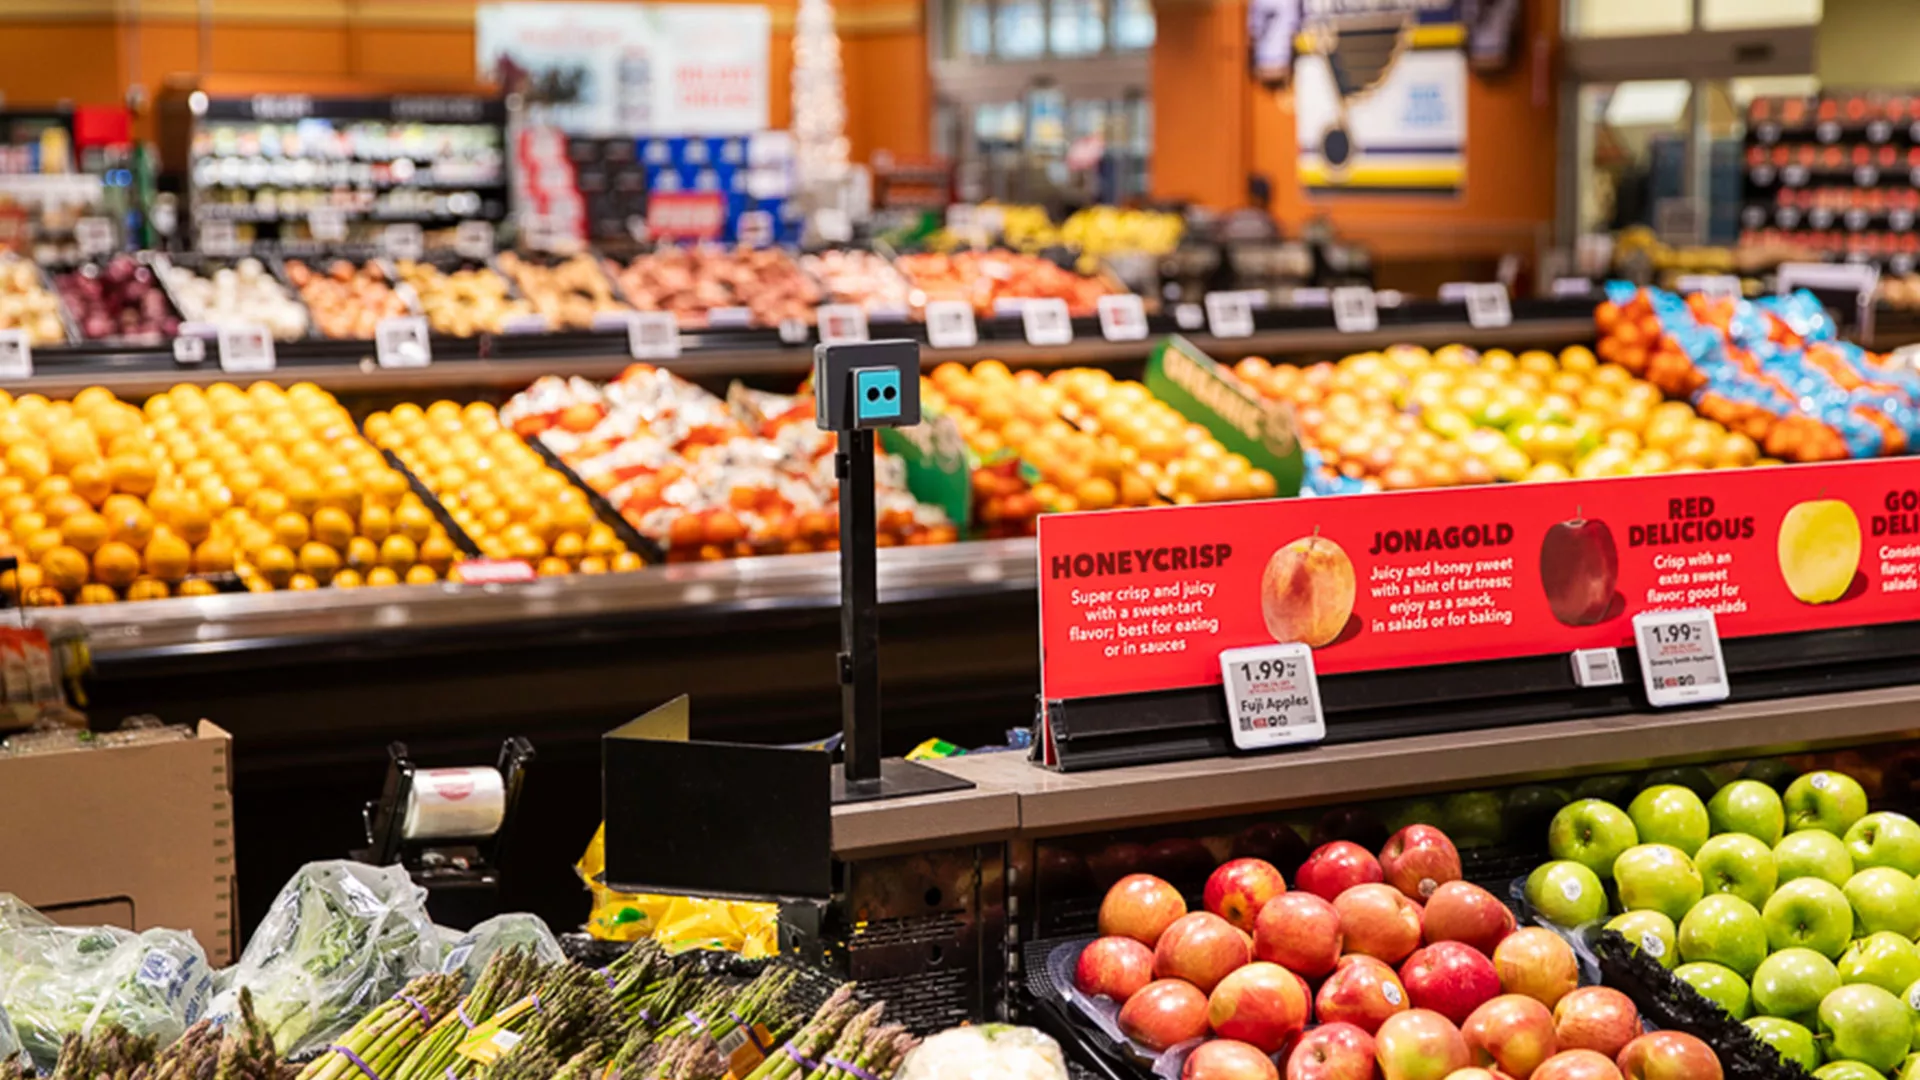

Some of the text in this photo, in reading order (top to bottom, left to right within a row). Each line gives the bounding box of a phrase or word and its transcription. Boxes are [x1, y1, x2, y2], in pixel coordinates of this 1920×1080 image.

[1668, 496, 1715, 520] RED
[1884, 489, 1920, 512] GO
[1628, 516, 1755, 547] DELICIOUS
[1871, 513, 1919, 537] DELI
[1369, 522, 1514, 555] JONAGOLD
[1052, 543, 1232, 579] HONEYCRISP
[1370, 557, 1513, 582] Juicy and honey sweet
[1653, 551, 1732, 570] Crisp with an
[1371, 576, 1512, 598] with a hint of tartness;
[1658, 568, 1728, 586] extra sweet
[1882, 576, 1918, 592] salads
[1071, 580, 1216, 607] Super crisp and juicy
[1646, 582, 1739, 603] flavor; good for
[1085, 600, 1203, 621] with a sweet-tart
[1389, 592, 1495, 617] enjoy as a snack,
[1710, 599, 1747, 614] salads
[1069, 617, 1219, 641] flavor; best for eating
[1372, 609, 1513, 633] in salads or for baking
[1652, 623, 1691, 644] 1.99
[1104, 638, 1186, 657] or in sauces
[1241, 659, 1285, 682] 1.99
[1241, 694, 1309, 714] Fuji Apples
